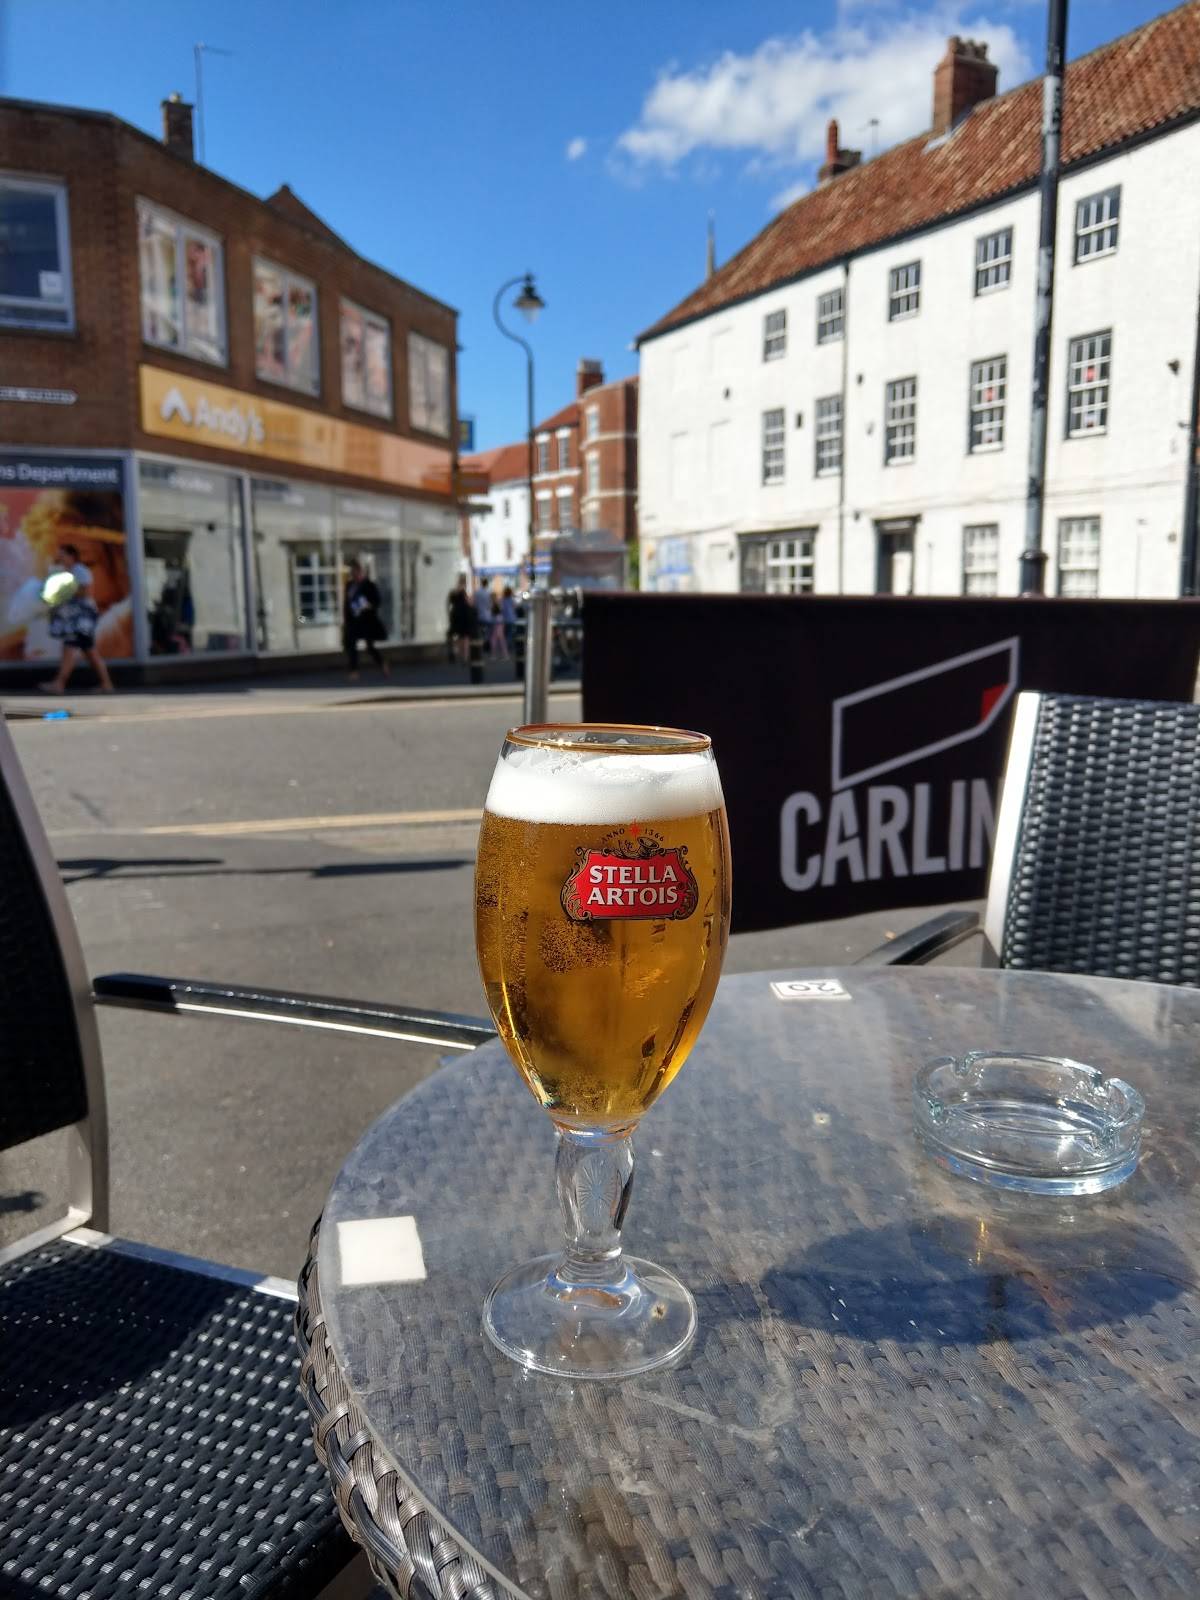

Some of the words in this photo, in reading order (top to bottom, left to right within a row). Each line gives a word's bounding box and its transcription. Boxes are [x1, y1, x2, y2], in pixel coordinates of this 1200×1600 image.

[194, 393, 266, 447] Andy's
[17, 463, 118, 484] Department
[601, 828, 625, 844] ANNO
[644, 828, 664, 842] 1366
[589, 865, 678, 884] STELLA
[587, 886, 678, 906] ARTOIS
